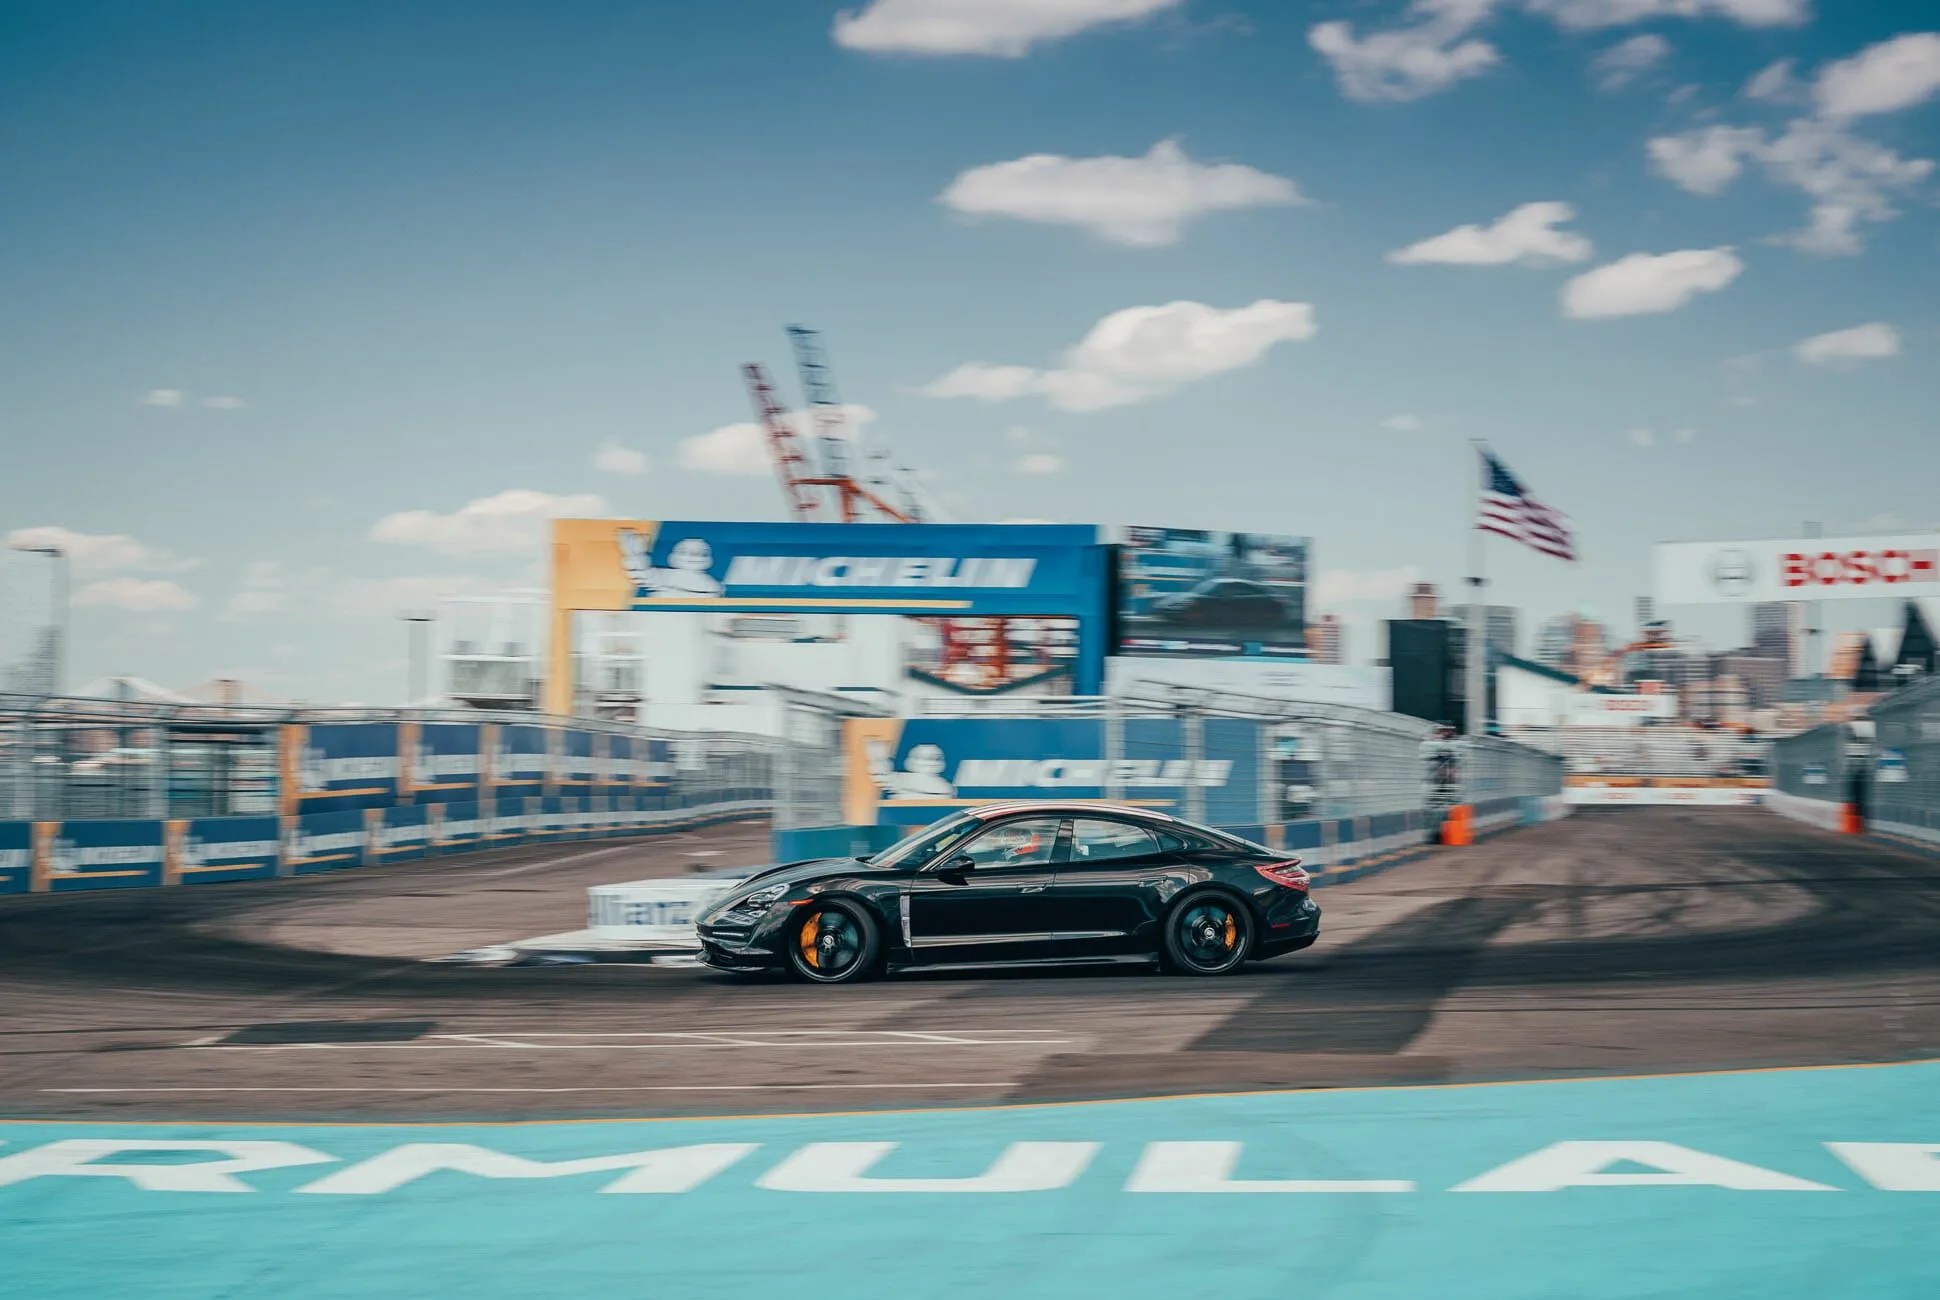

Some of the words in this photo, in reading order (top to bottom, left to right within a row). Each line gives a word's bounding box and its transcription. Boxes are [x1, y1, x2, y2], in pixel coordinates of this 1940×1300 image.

[724, 556, 1037, 588] MICHELIN
[1779, 549, 1938, 587] BOSCH
[0, 1138, 1847, 1194] RMULA
